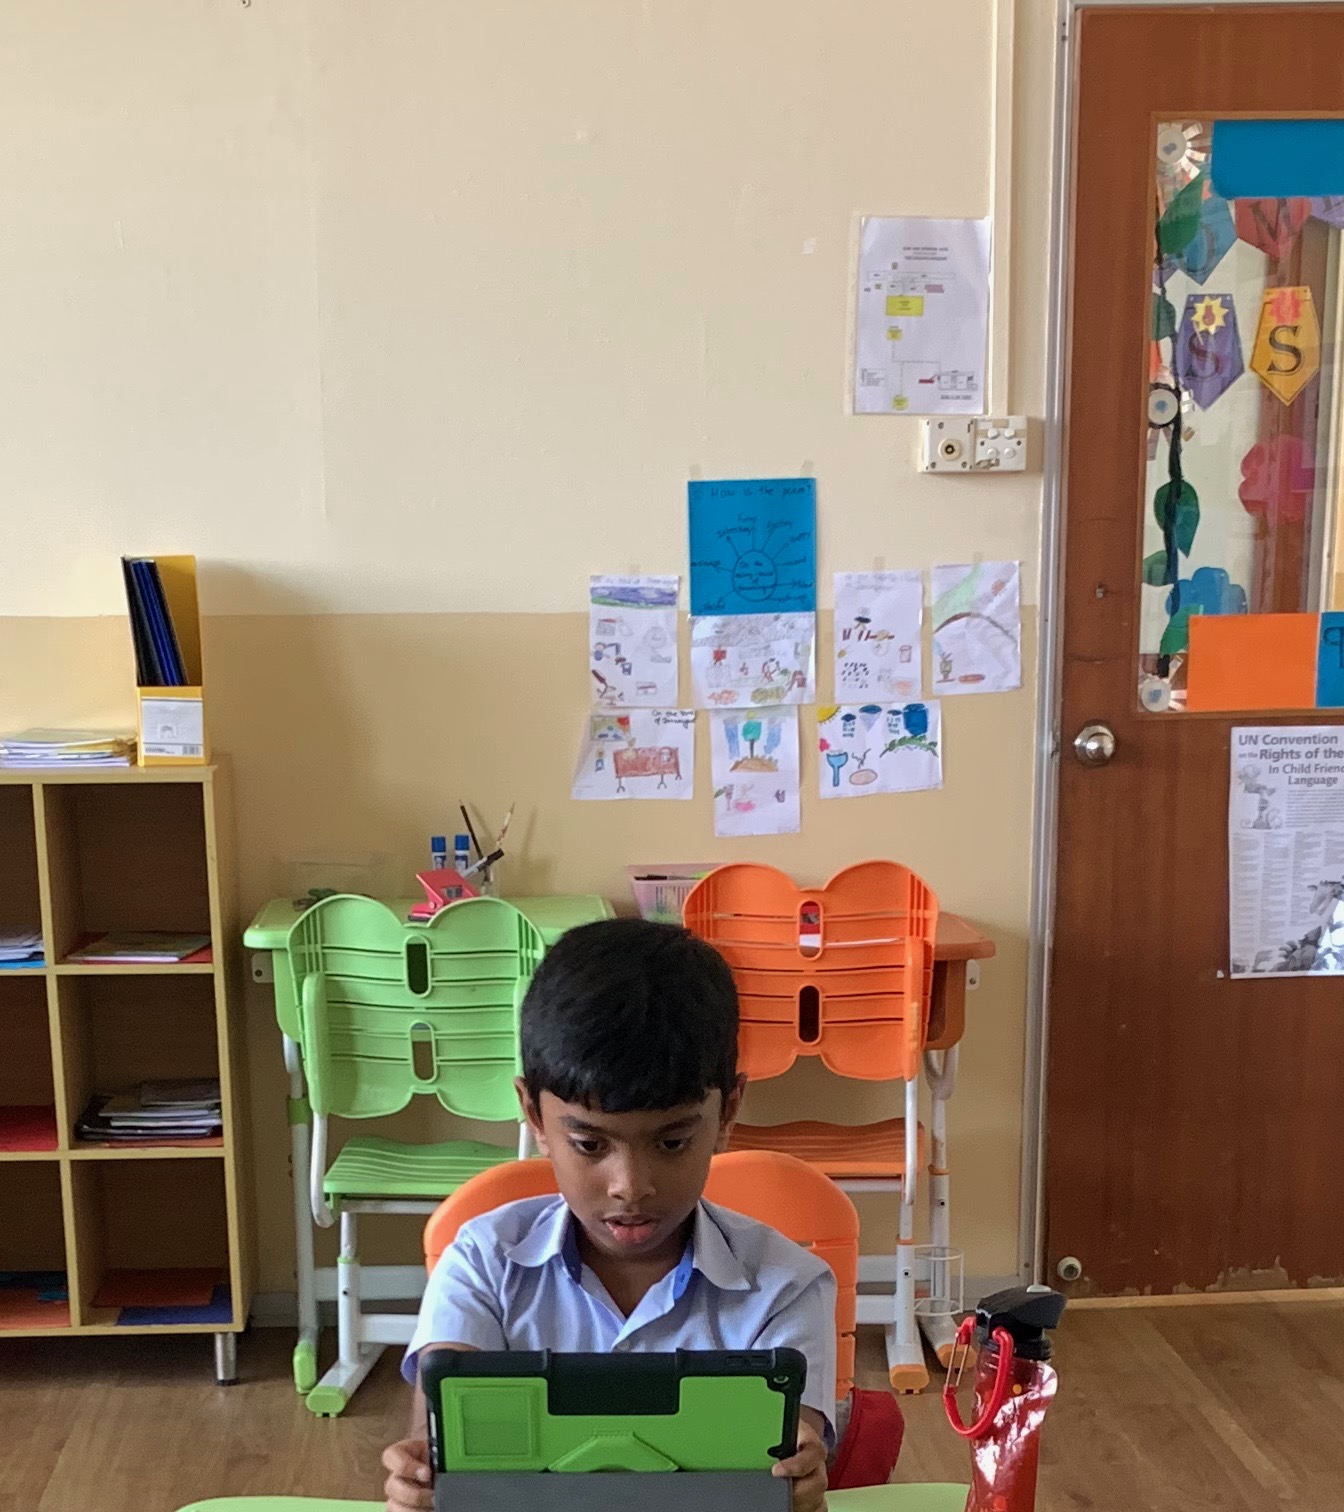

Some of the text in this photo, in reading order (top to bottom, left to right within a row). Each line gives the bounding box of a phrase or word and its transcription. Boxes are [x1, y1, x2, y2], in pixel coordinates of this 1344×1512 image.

[1238, 734, 1338, 746] UN Convention
[1259, 748, 1301, 762] Rights
[1305, 747, 1319, 759] of
[1323, 747, 1344, 759] the
[1268, 765, 1279, 774] In
[1282, 764, 1311, 774] Child
[1287, 775, 1338, 787] Language
